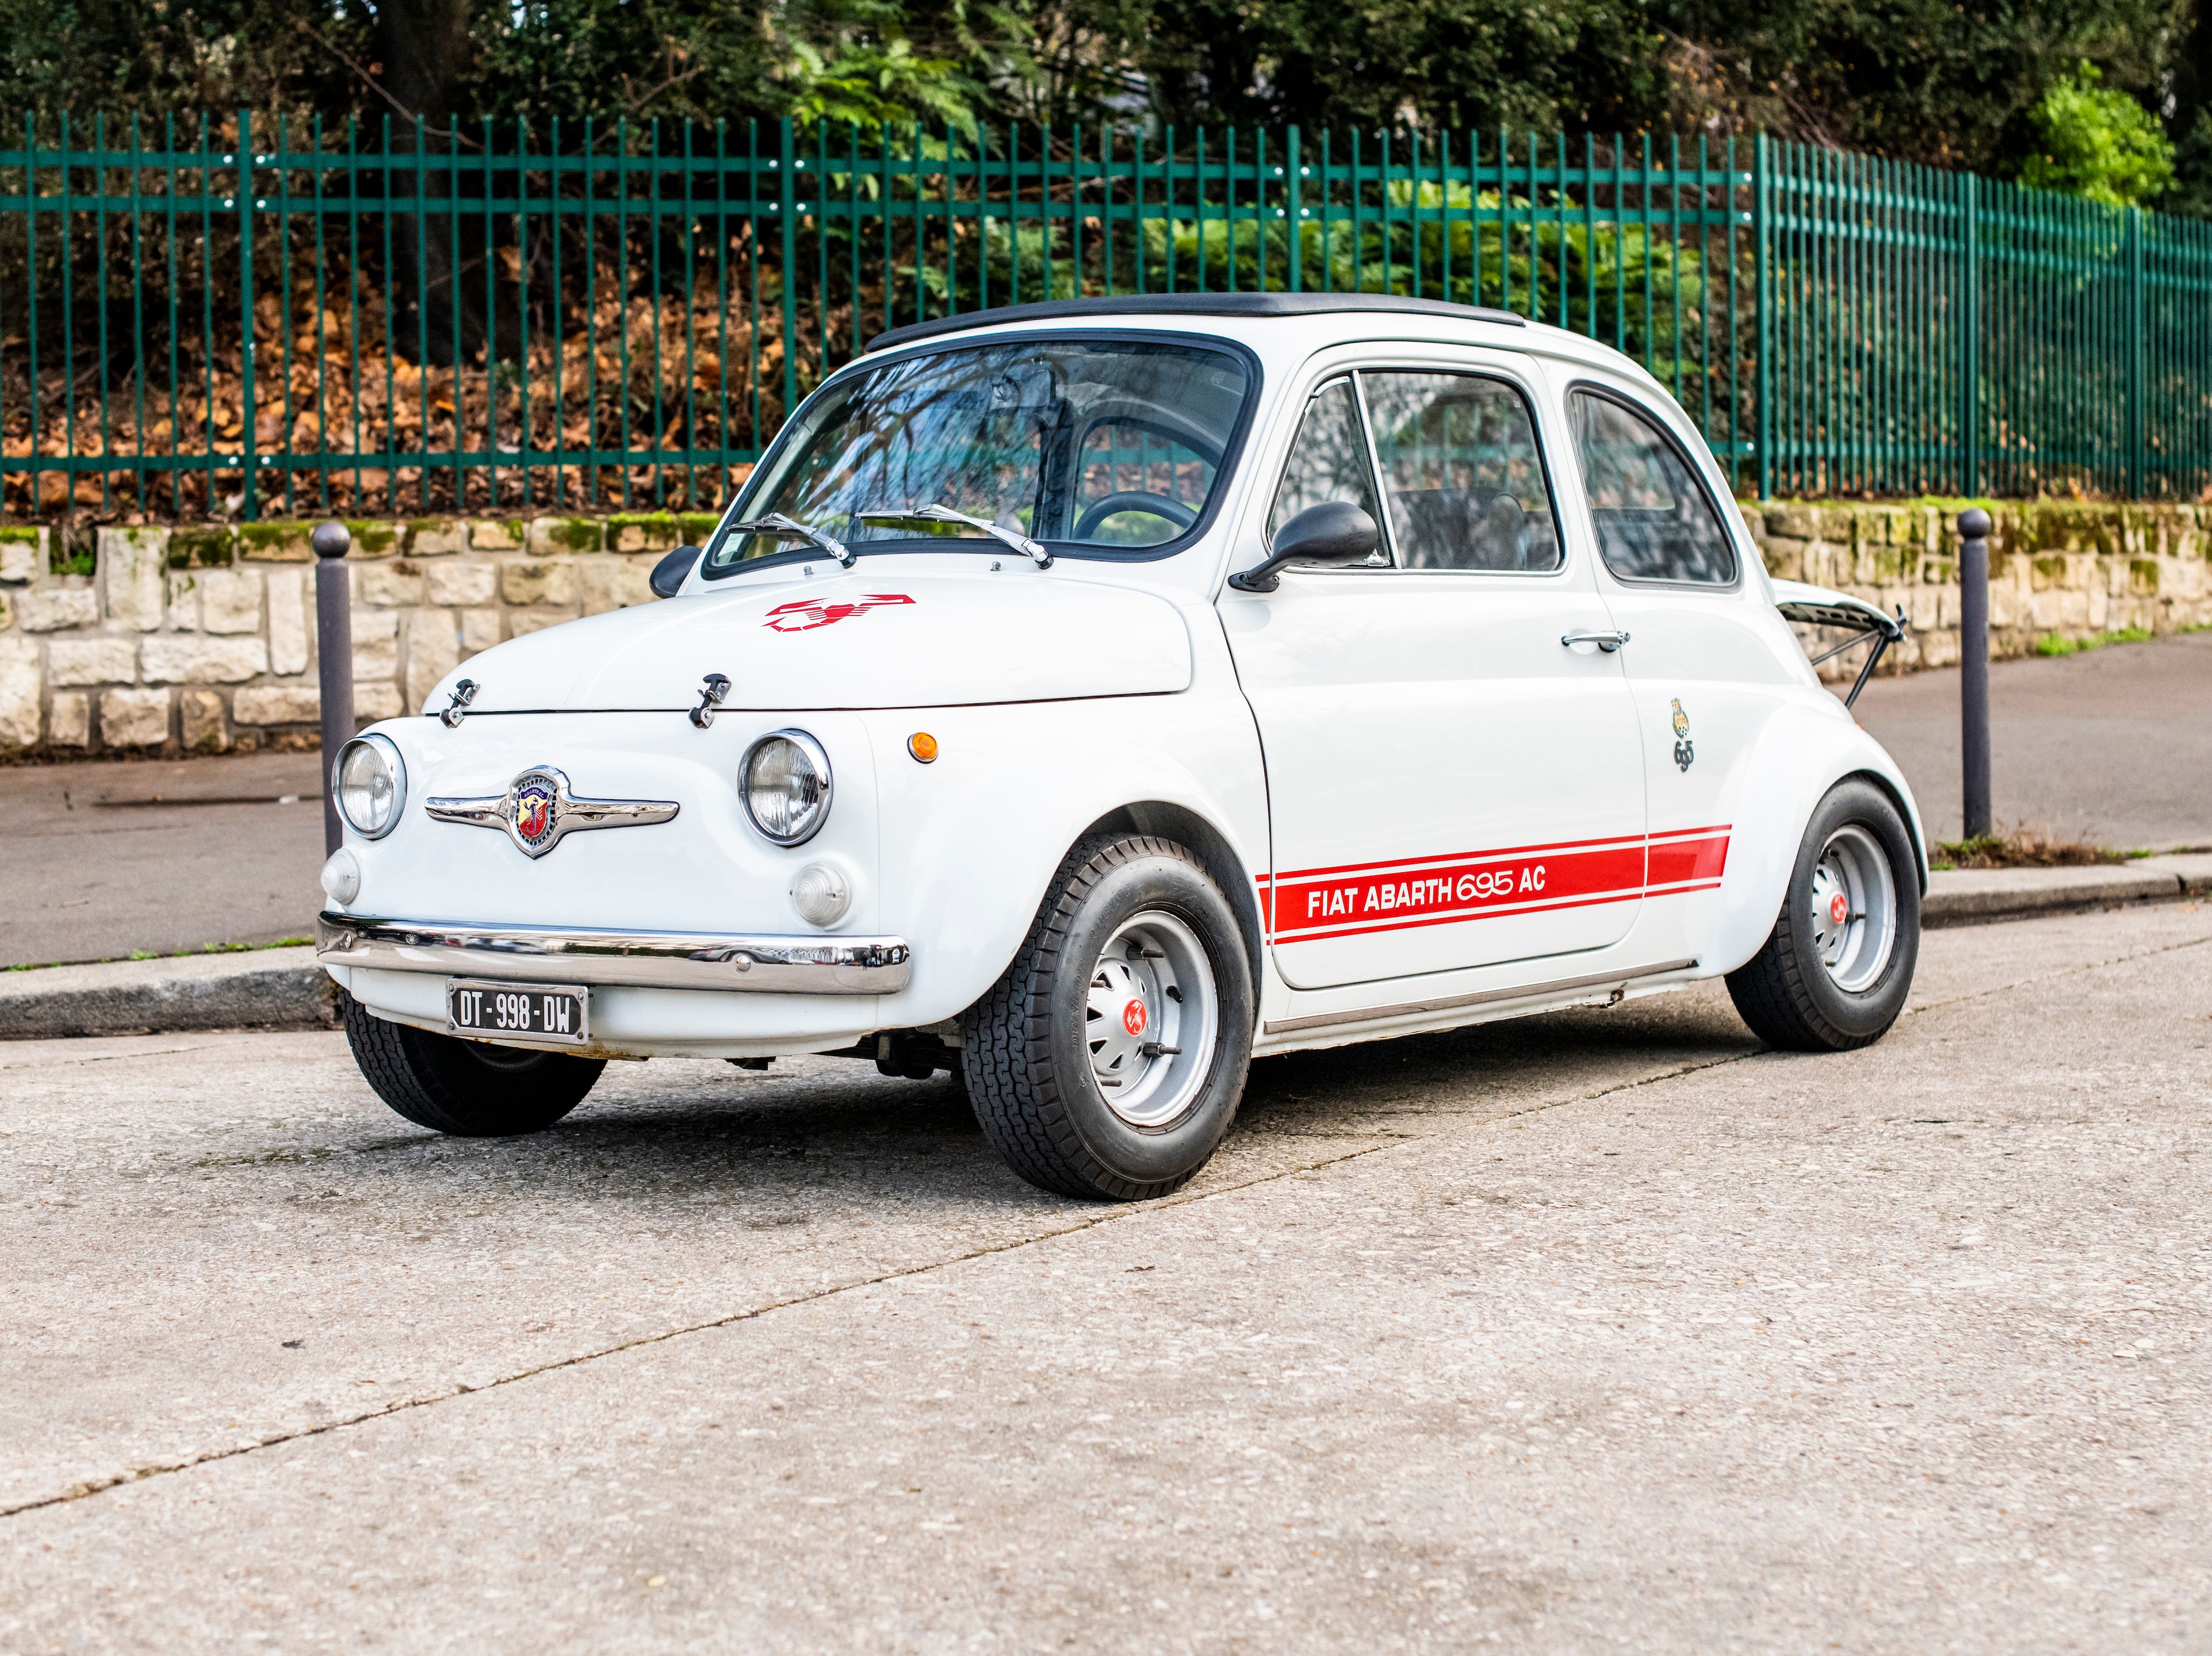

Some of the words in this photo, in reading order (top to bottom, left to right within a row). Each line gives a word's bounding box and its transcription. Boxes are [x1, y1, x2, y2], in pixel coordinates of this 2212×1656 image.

[1674, 741, 1694, 773] 695
[524, 789, 539, 798] ABARTH
[1308, 887, 1358, 918] FIAT
[1364, 877, 1452, 912] ABARTH
[1456, 870, 1514, 901] 695
[1518, 865, 1546, 893] AC
[460, 990, 570, 1033] DT-998-DW
